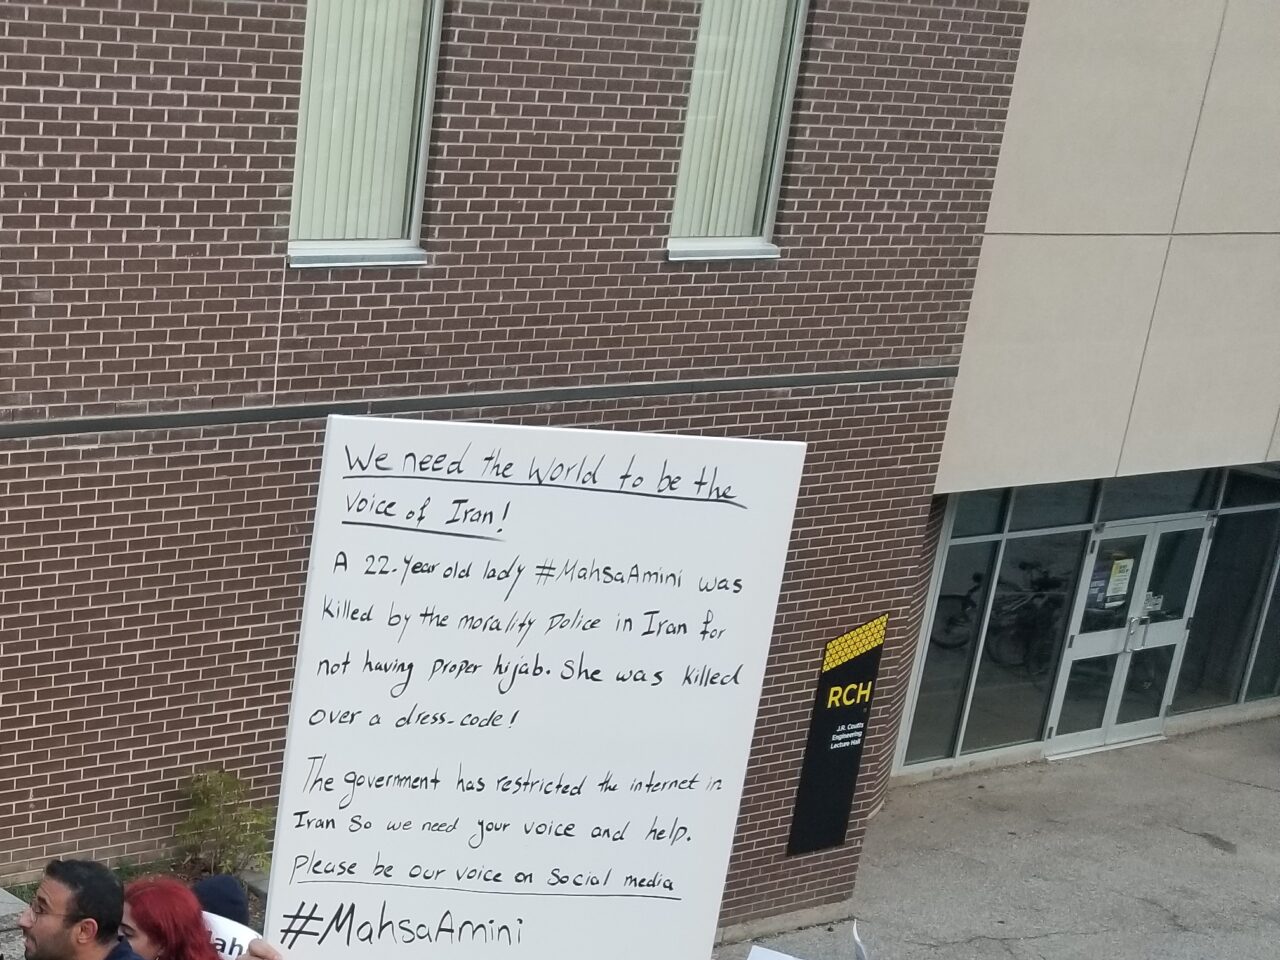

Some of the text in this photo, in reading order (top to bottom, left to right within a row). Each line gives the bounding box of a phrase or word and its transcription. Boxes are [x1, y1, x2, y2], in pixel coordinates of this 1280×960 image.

[345, 443, 393, 471] We
[403, 441, 472, 474] need
[482, 448, 514, 479] the
[620, 454, 644, 489] to
[658, 459, 681, 493] be
[694, 466, 737, 500] the
[406, 496, 430, 527] of
[445, 499, 511, 533] Iran!
[333, 551, 348, 573] A
[442, 561, 473, 580] old
[483, 555, 525, 601] lady
[535, 558, 683, 588] #MahsaAmini
[698, 577, 743, 593] was
[387, 601, 411, 644] by
[420, 604, 449, 627] the
[458, 611, 536, 648] morality
[616, 613, 633, 632] in
[641, 610, 688, 637] Iran
[699, 609, 726, 641] for
[317, 651, 351, 676] not
[362, 649, 414, 699] having
[493, 652, 551, 695] hijab.
[561, 650, 603, 682] She
[616, 669, 664, 686] was
[827, 681, 872, 708] RCH
[369, 713, 381, 726] a
[831, 731, 863, 741] Engineering
[830, 741, 850, 749] Lecture
[303, 753, 335, 794] The
[456, 762, 485, 793] has
[496, 769, 588, 796] restricted
[597, 770, 619, 793] the
[630, 770, 700, 794] internet
[705, 777, 722, 792] in
[293, 810, 336, 830] Iran
[386, 819, 413, 832] we
[421, 817, 459, 833] need
[468, 819, 510, 849] your
[524, 820, 576, 838] voice
[590, 821, 630, 842] and
[645, 815, 692, 846] help.
[373, 851, 393, 878] be
[456, 865, 503, 883] voice
[514, 871, 533, 884] on
[623, 871, 674, 891] media
[280, 900, 523, 949] #MahsaAmini
